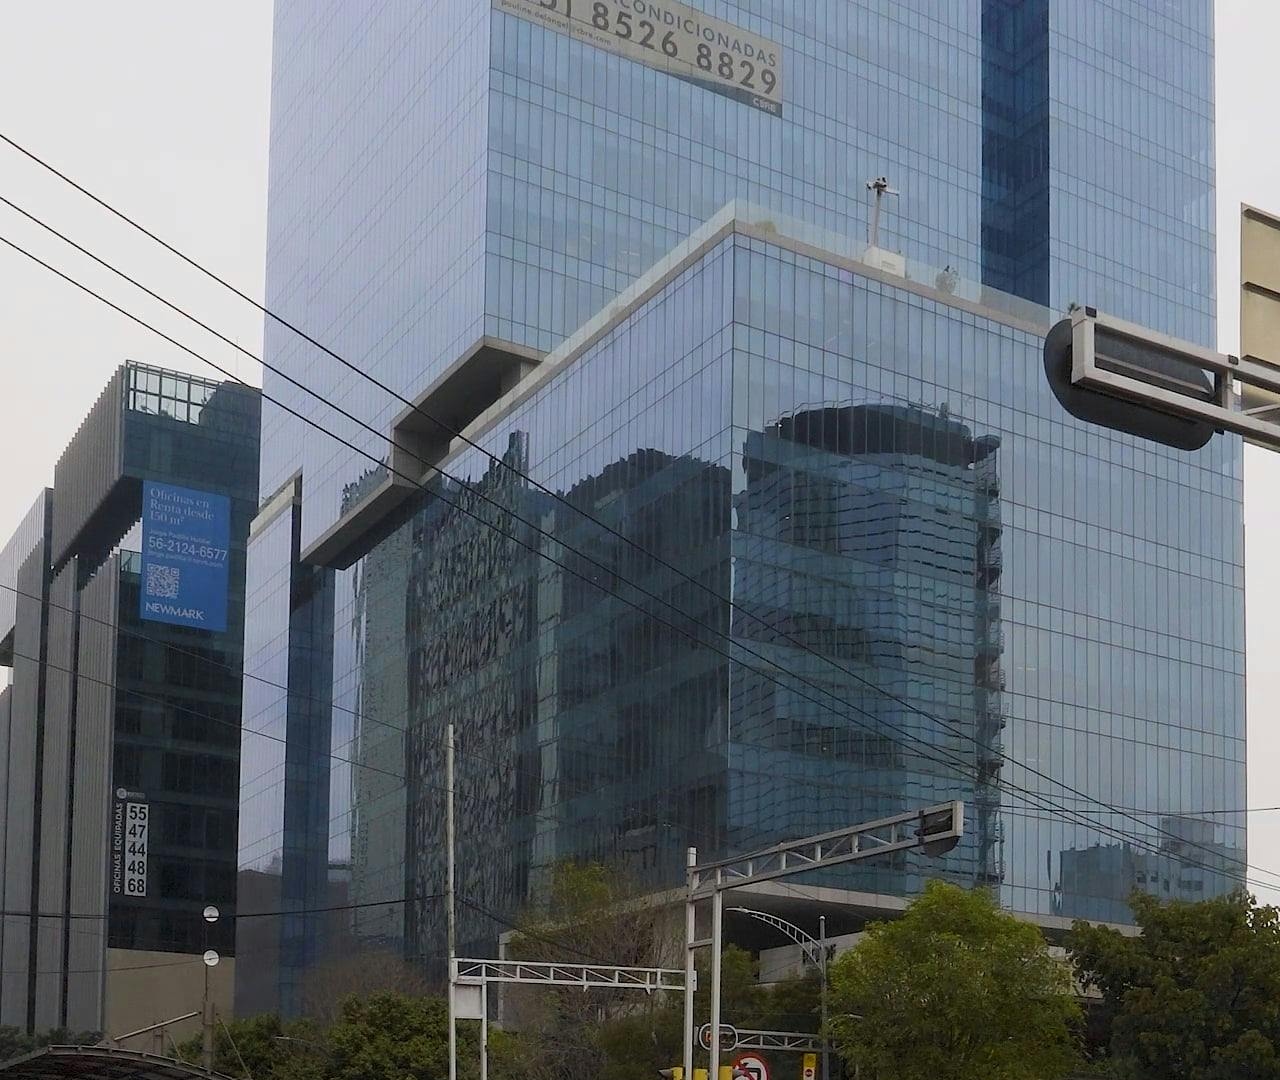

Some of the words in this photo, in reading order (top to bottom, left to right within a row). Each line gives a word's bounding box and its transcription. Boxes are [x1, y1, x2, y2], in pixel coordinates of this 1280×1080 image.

[613, 0, 777, 67] CONDICIONADAS
[592, 2, 678, 58] 8526
[696, 43, 776, 95] 8829
[150, 487, 194, 505] Oficinas
[196, 500, 210, 508] en
[150, 498, 181, 514] Renta
[184, 506, 215, 520] desde
[150, 510, 168, 523] 150
[149, 536, 227, 561] 56-2124-6577
[145, 602, 205, 621] NEWMARK
[129, 805, 147, 820] 55
[114, 803, 123, 851] EQUIPADAS
[128, 823, 146, 838] 47
[128, 842, 146, 857] 44
[113, 854, 121, 893] OFICINAS
[128, 860, 145, 875] 48
[128, 879, 145, 893] 68
